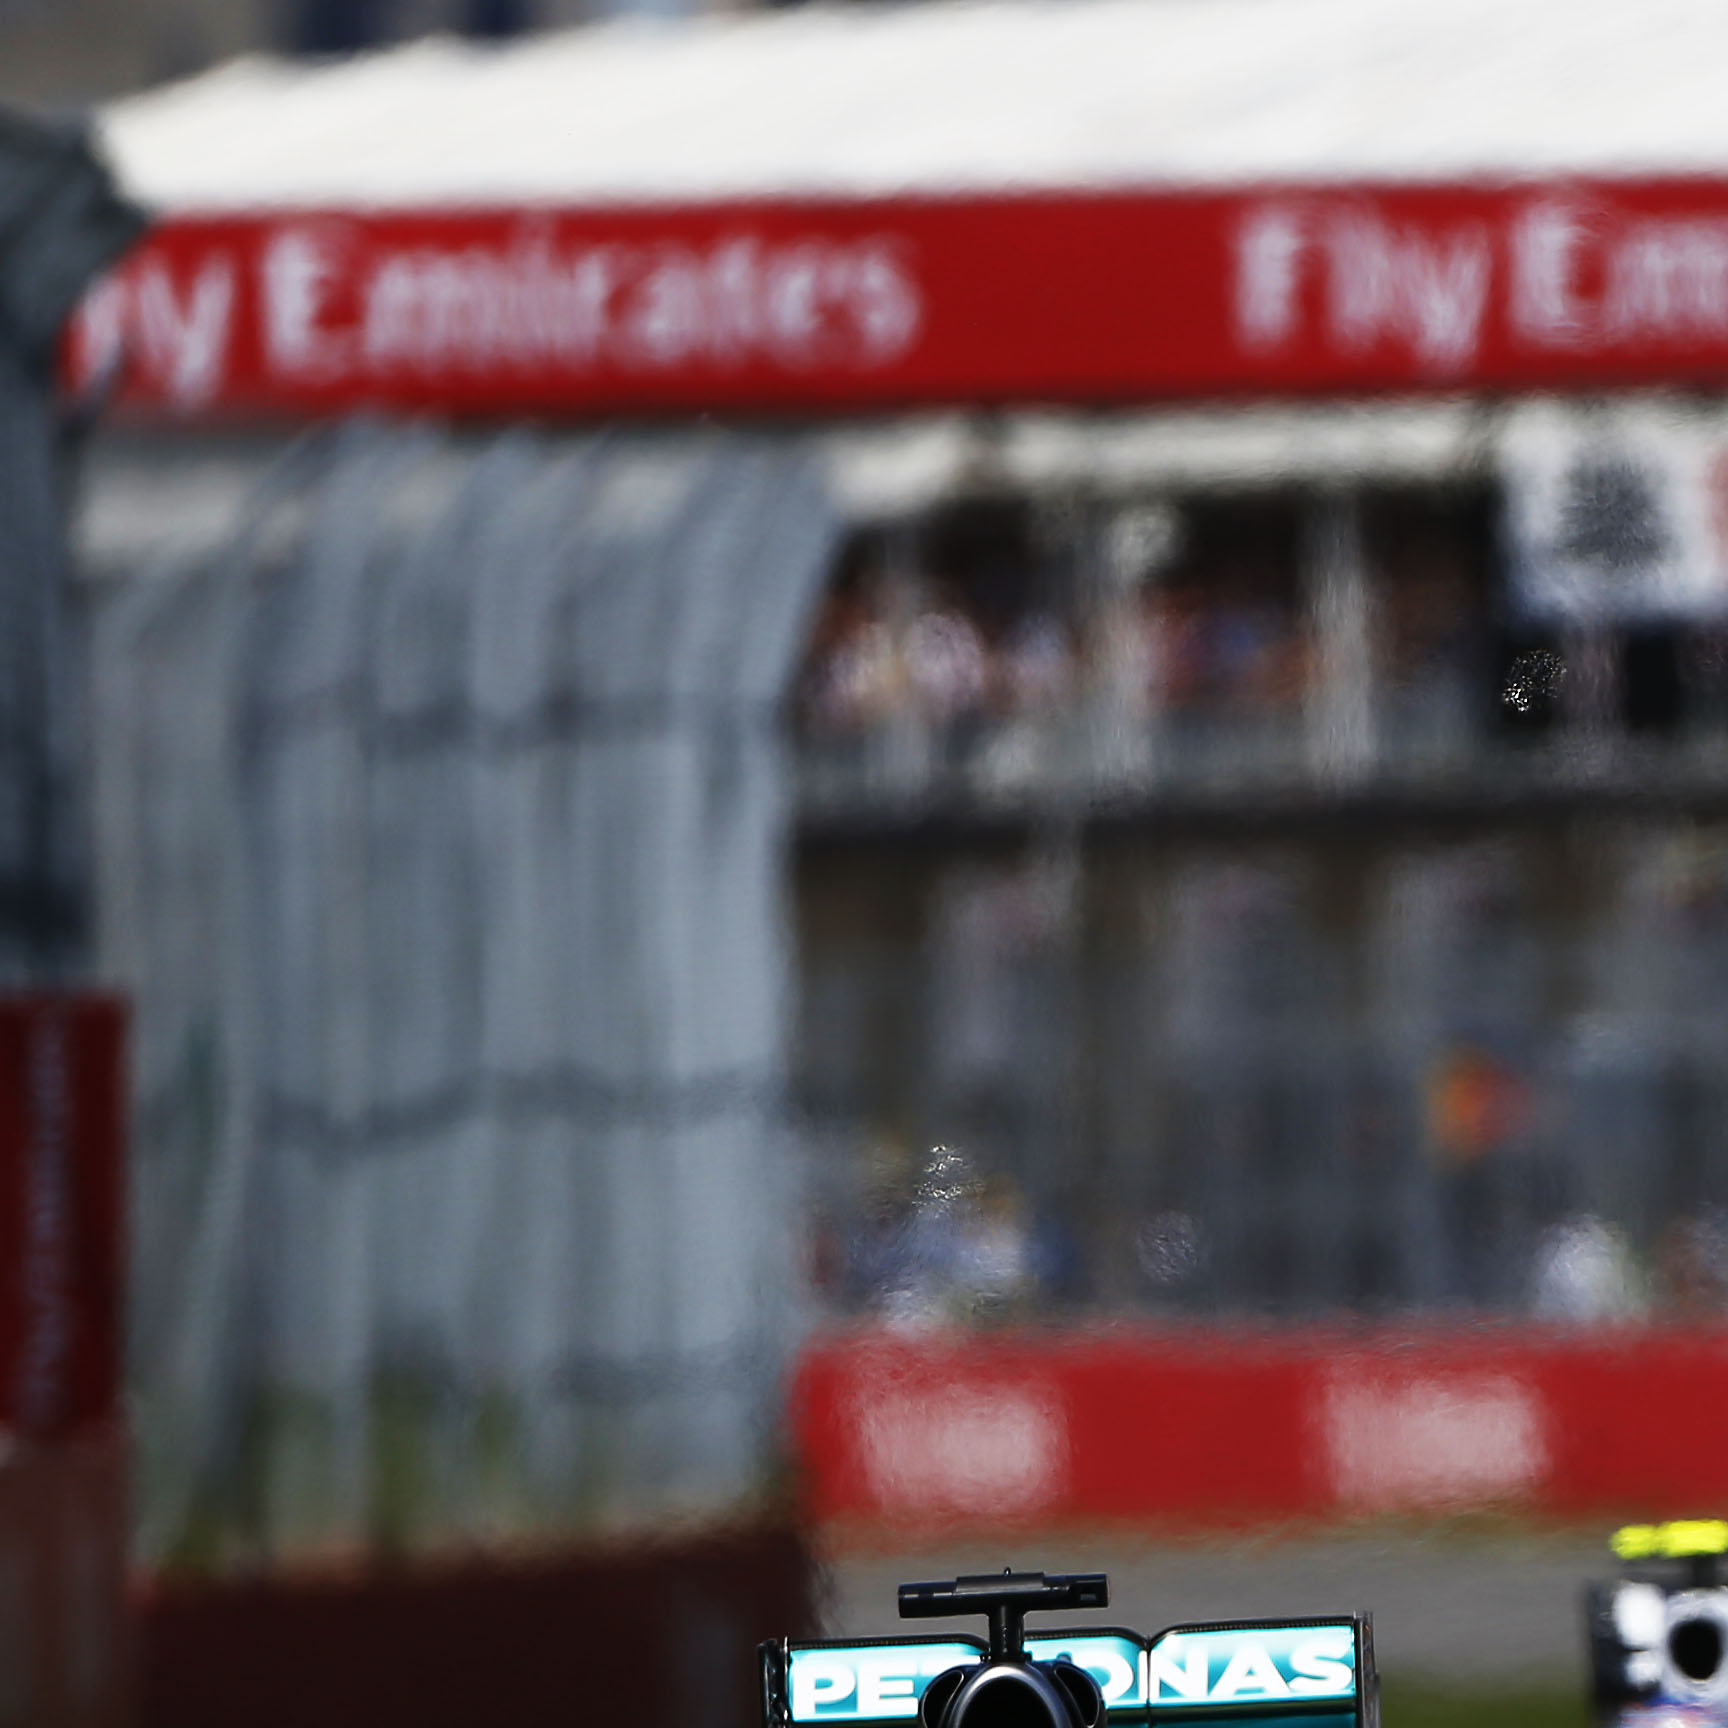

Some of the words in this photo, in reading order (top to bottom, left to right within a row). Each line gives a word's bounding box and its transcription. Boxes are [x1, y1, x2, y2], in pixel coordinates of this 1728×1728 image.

[80, 245, 236, 408] ly
[262, 215, 925, 380] Emirates
[1232, 212, 1487, 372] Fly
[793, 1637, 1352, 1720] PEONAS
